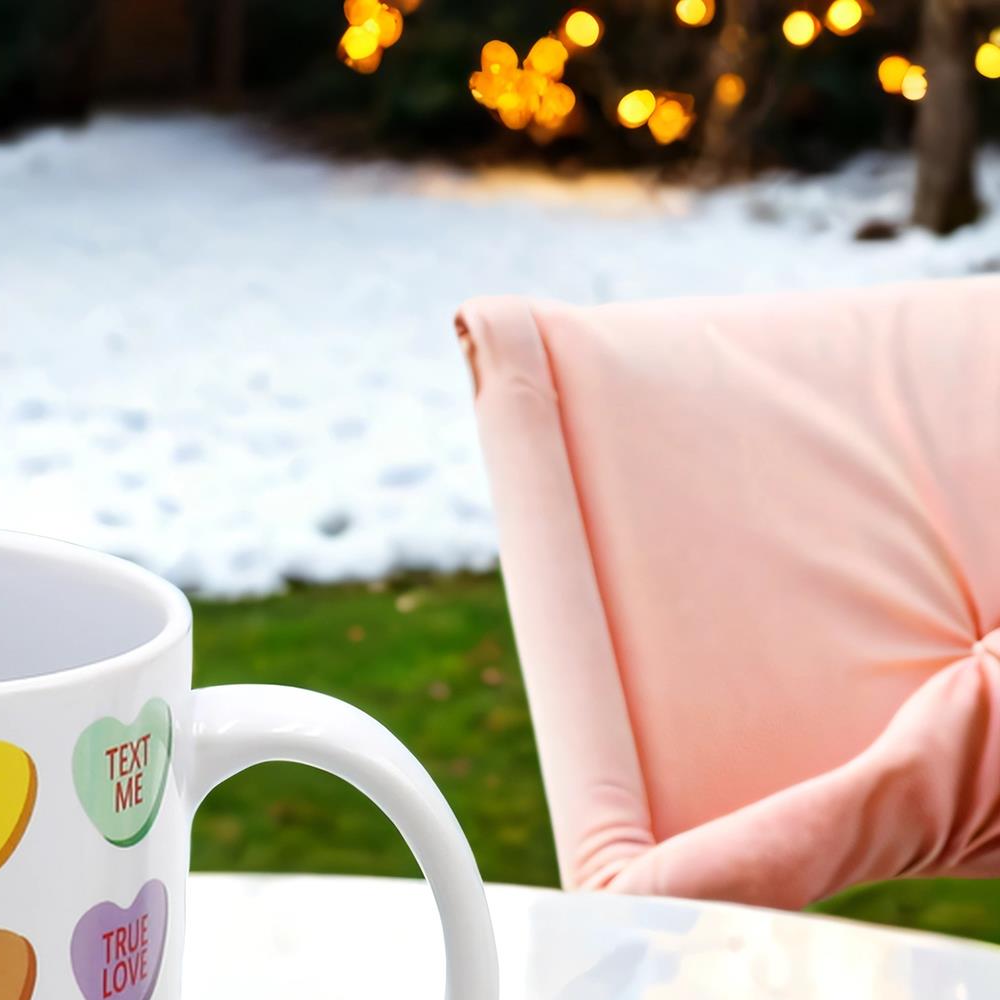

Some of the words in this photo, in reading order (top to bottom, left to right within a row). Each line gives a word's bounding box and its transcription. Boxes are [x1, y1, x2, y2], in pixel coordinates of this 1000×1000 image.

[105, 733, 151, 780] TEXT
[115, 772, 143, 813] ME
[103, 914, 148, 964] TRUE
[103, 950, 147, 999] LOVE
